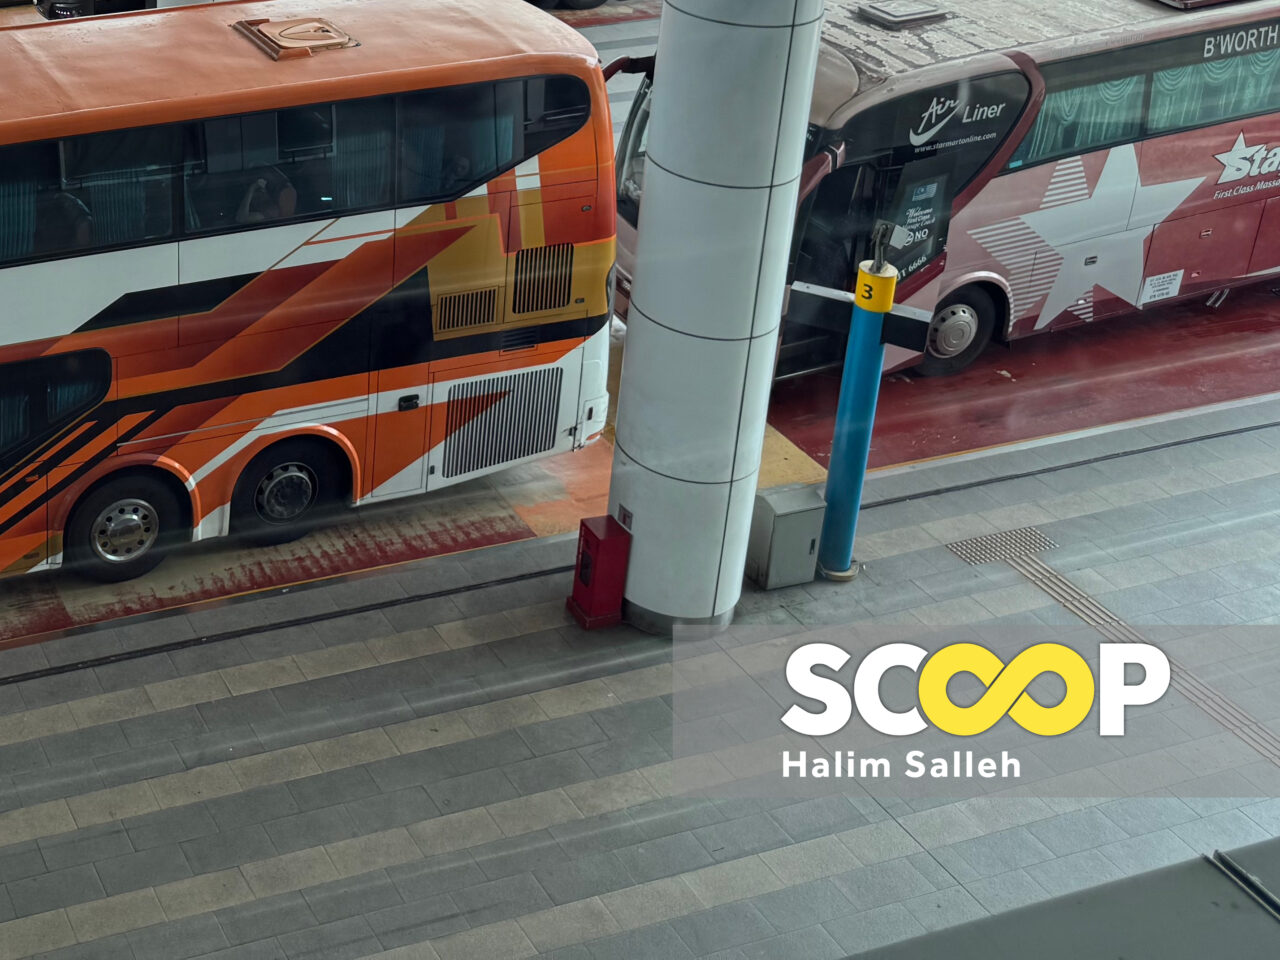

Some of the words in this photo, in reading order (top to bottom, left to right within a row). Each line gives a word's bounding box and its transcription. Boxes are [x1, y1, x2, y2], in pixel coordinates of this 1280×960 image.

[1203, 24, 1279, 58] B'WORTH
[918, 97, 961, 133] Air
[962, 102, 1006, 123] Liner
[914, 132, 997, 153] www.starmartonline.com
[1213, 189, 1232, 200] First
[1233, 185, 1255, 196] Class
[914, 228, 929, 240] NO
[908, 256, 927, 272] 6666
[861, 283, 873, 300] 3
